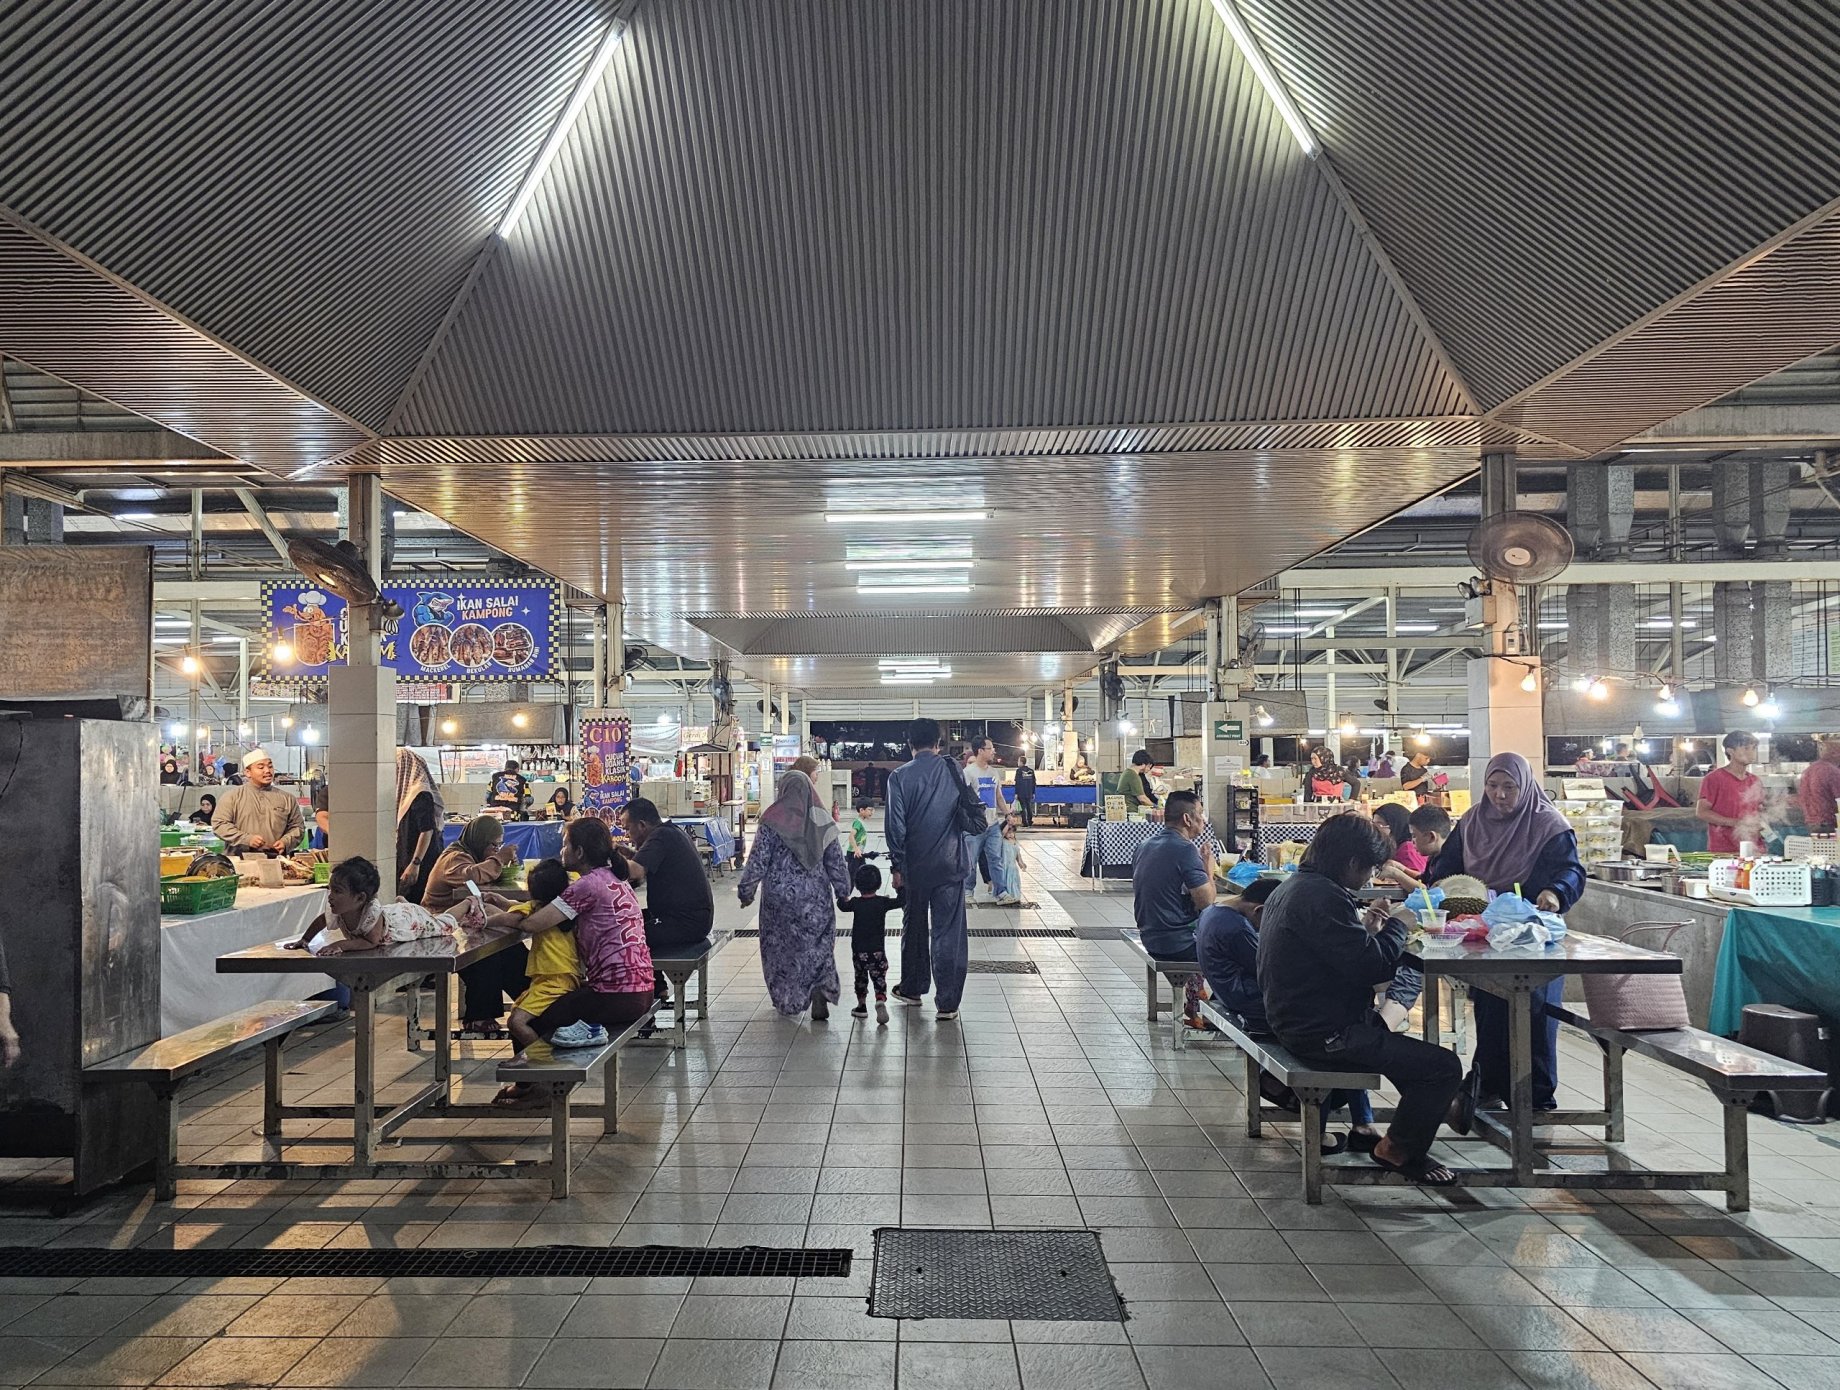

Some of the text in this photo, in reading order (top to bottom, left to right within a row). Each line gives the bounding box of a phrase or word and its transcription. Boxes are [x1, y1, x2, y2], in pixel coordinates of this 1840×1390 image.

[457, 595, 519, 610] IKAN SALAI
[462, 607, 513, 620] KAMPONG
[420, 663, 452, 673] MACKEREL
[590, 727, 622, 743] C10
